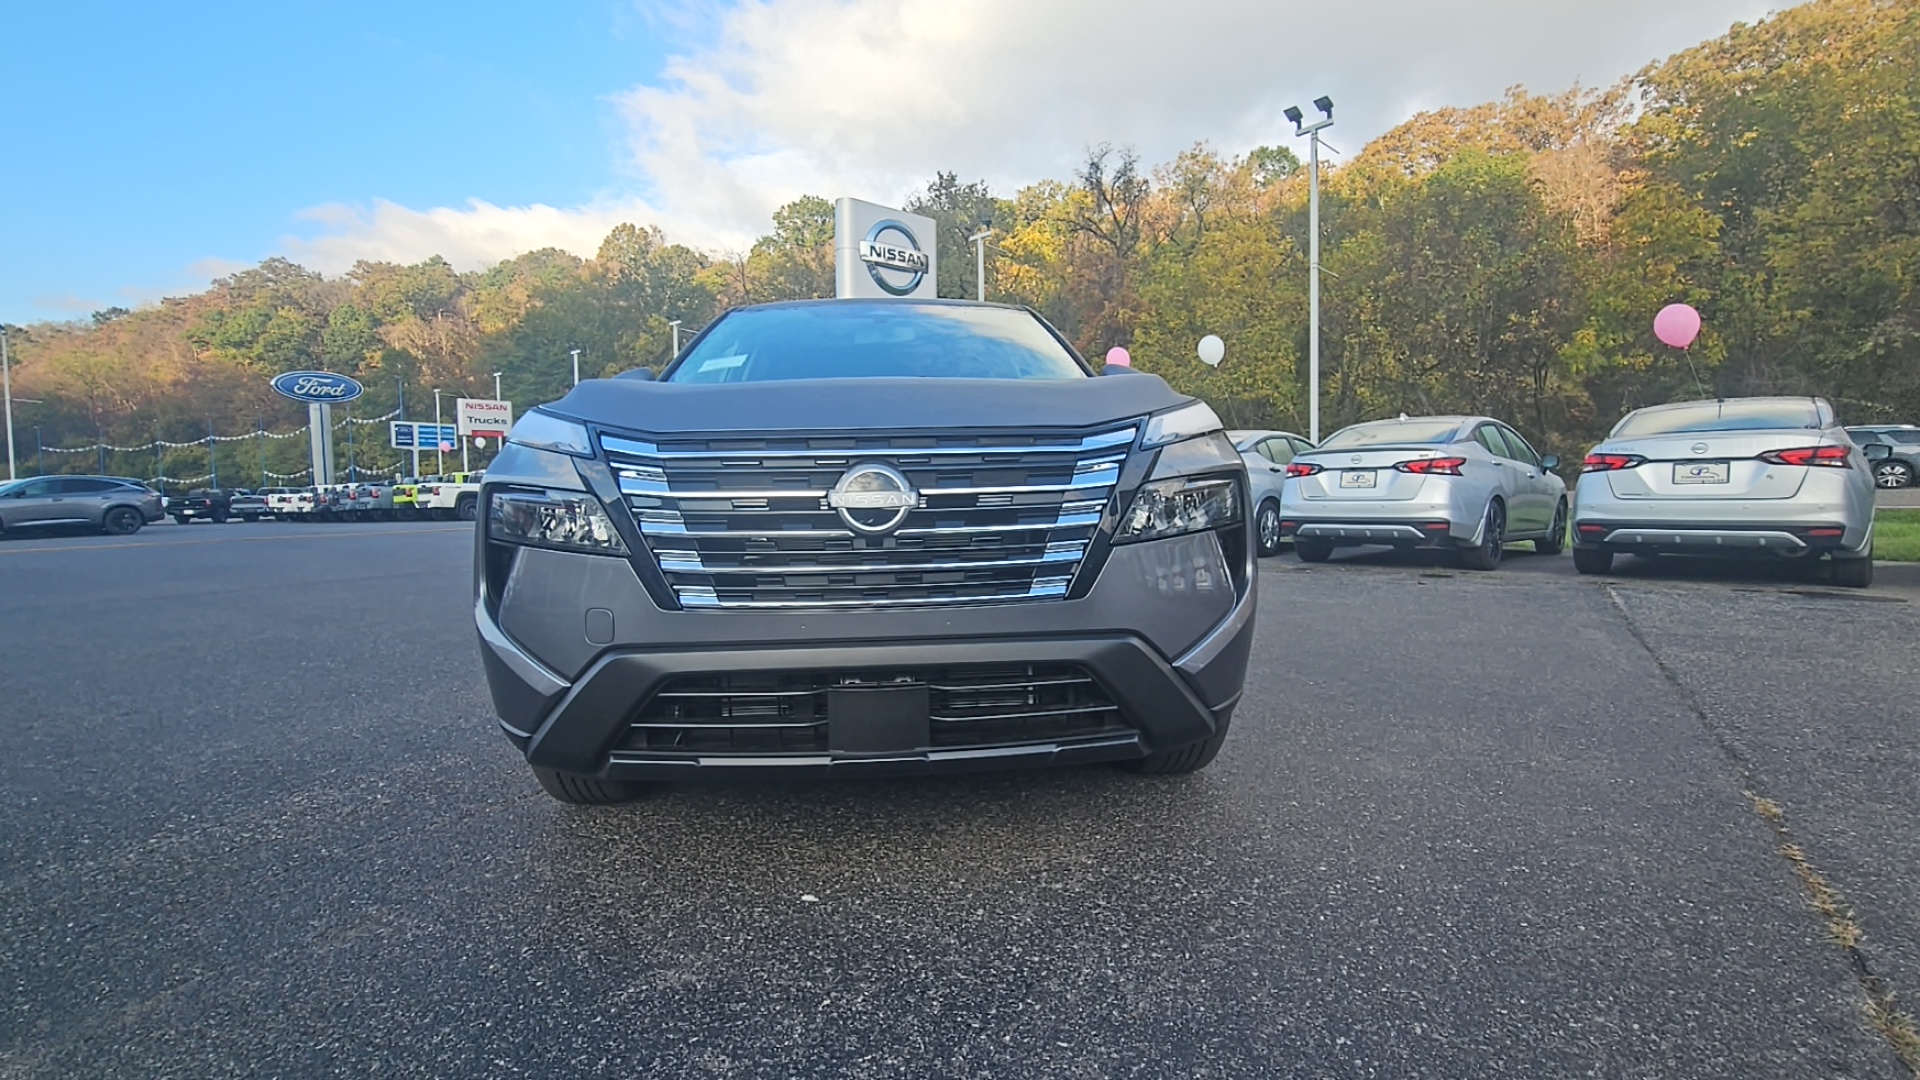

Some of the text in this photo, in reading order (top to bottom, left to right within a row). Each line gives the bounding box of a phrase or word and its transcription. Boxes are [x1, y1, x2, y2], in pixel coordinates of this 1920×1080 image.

[870, 245, 924, 267] NISSAN
[294, 376, 346, 396] Ford
[465, 402, 508, 411] NISSAN
[467, 416, 508, 425] Trucks
[833, 494, 914, 505] NISSAN
